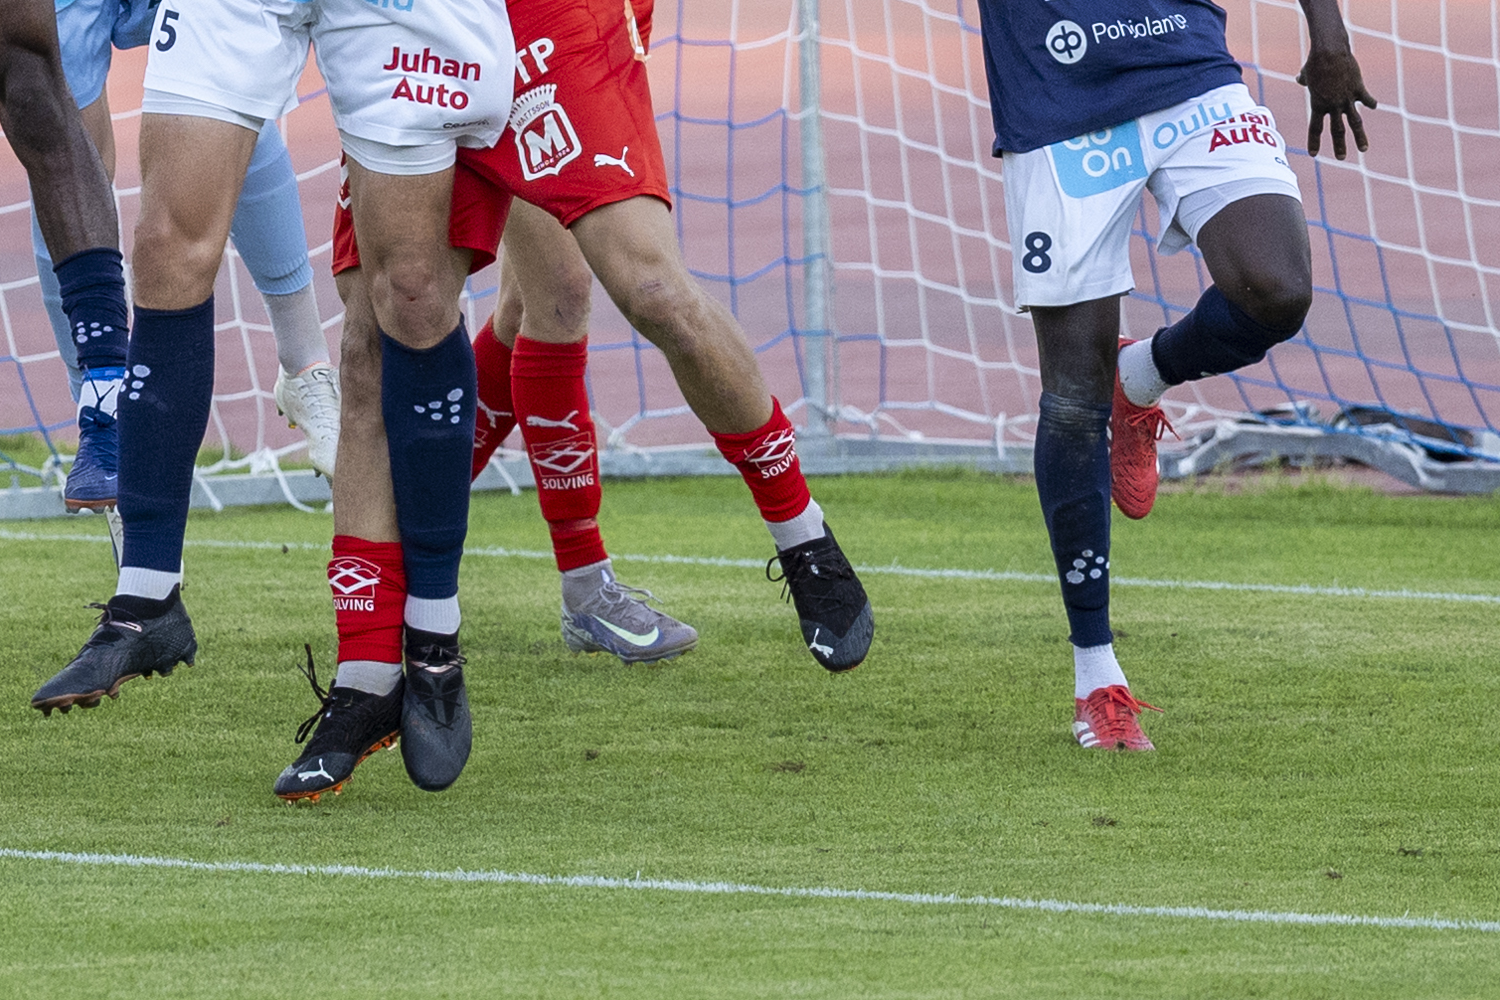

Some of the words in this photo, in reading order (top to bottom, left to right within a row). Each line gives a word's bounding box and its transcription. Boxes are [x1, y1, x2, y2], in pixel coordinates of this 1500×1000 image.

[155, 8, 181, 53] 5
[1091, 15, 1175, 44] Pohjolan
[382, 45, 482, 82] Juhan
[515, 36, 556, 85] TP
[390, 75, 470, 111] Auto
[1152, 102, 1233, 150] Oulu
[1208, 124, 1278, 154] Auto
[1081, 146, 1133, 178] On
[1021, 230, 1053, 274] 8
[760, 444, 797, 480] SOLVIN
[541, 473, 595, 491] SOLVING
[332, 598, 376, 612] OLVING
